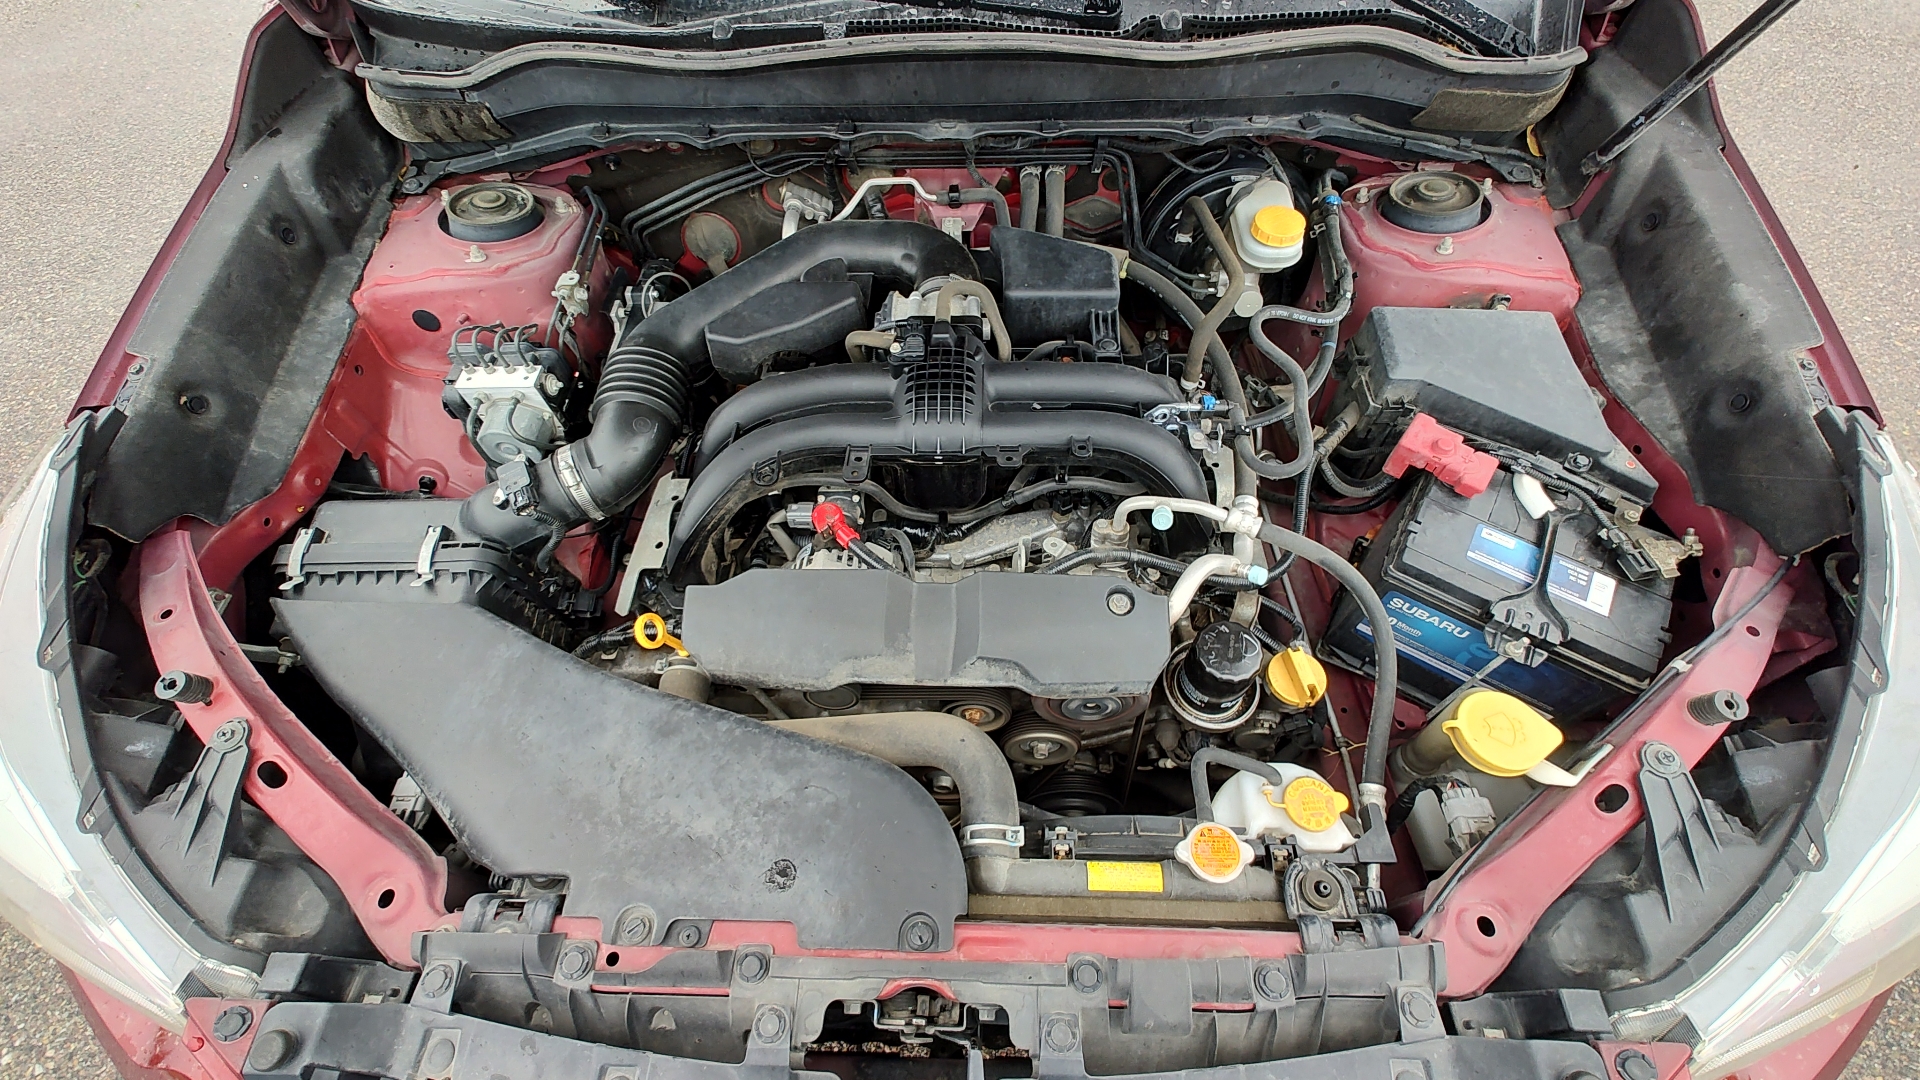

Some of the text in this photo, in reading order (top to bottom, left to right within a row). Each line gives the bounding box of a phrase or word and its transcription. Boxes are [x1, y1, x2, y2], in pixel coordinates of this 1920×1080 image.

[1389, 597, 1471, 639] SUBARU
[1396, 621, 1423, 636] Month
[1288, 779, 1331, 798] COOLANT
